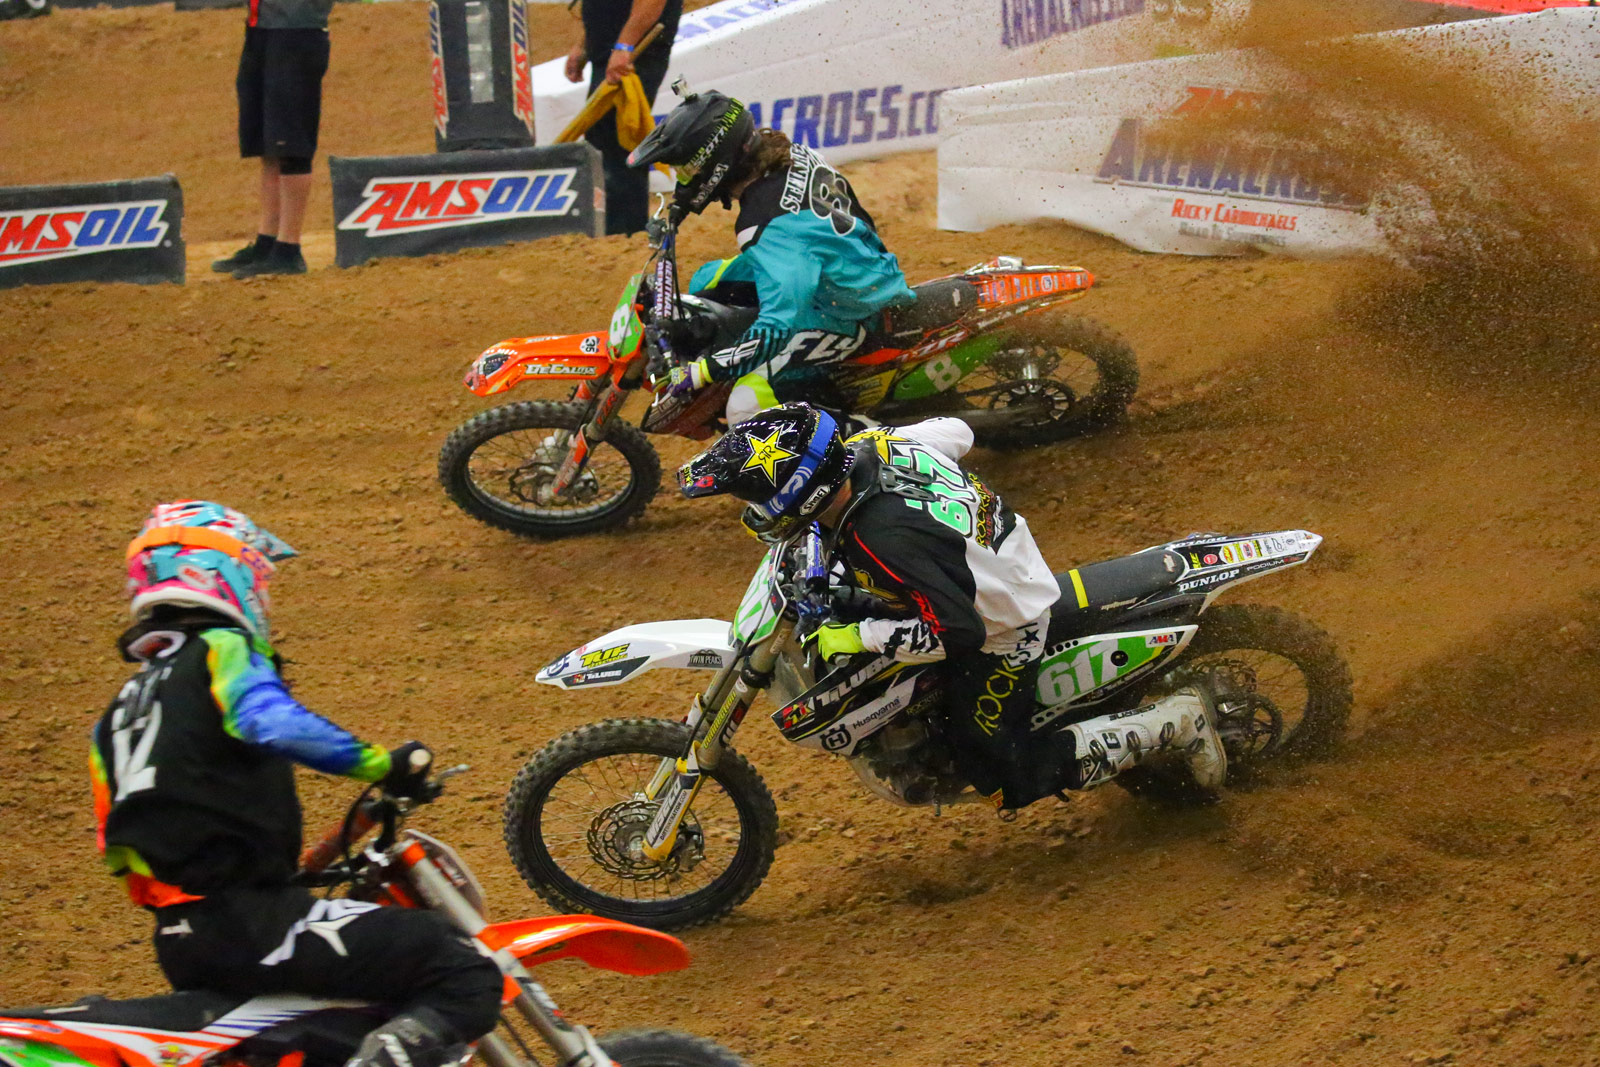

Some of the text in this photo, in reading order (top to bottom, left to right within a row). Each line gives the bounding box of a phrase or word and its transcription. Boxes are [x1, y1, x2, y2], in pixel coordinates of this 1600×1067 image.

[353, 174, 570, 231] AMSOIL
[809, 163, 856, 236] 8
[0, 206, 162, 262] MSOIL
[664, 259, 673, 318] RENTHAL
[924, 353, 962, 392] 8
[802, 486, 829, 512] SHOEI
[1179, 569, 1240, 593] DUNLOP
[581, 643, 630, 668] TUF
[1150, 634, 1174, 645] AMA
[705, 655, 722, 665] PEAKS
[1037, 639, 1119, 706] 617
[852, 696, 900, 730] Husqvarna
